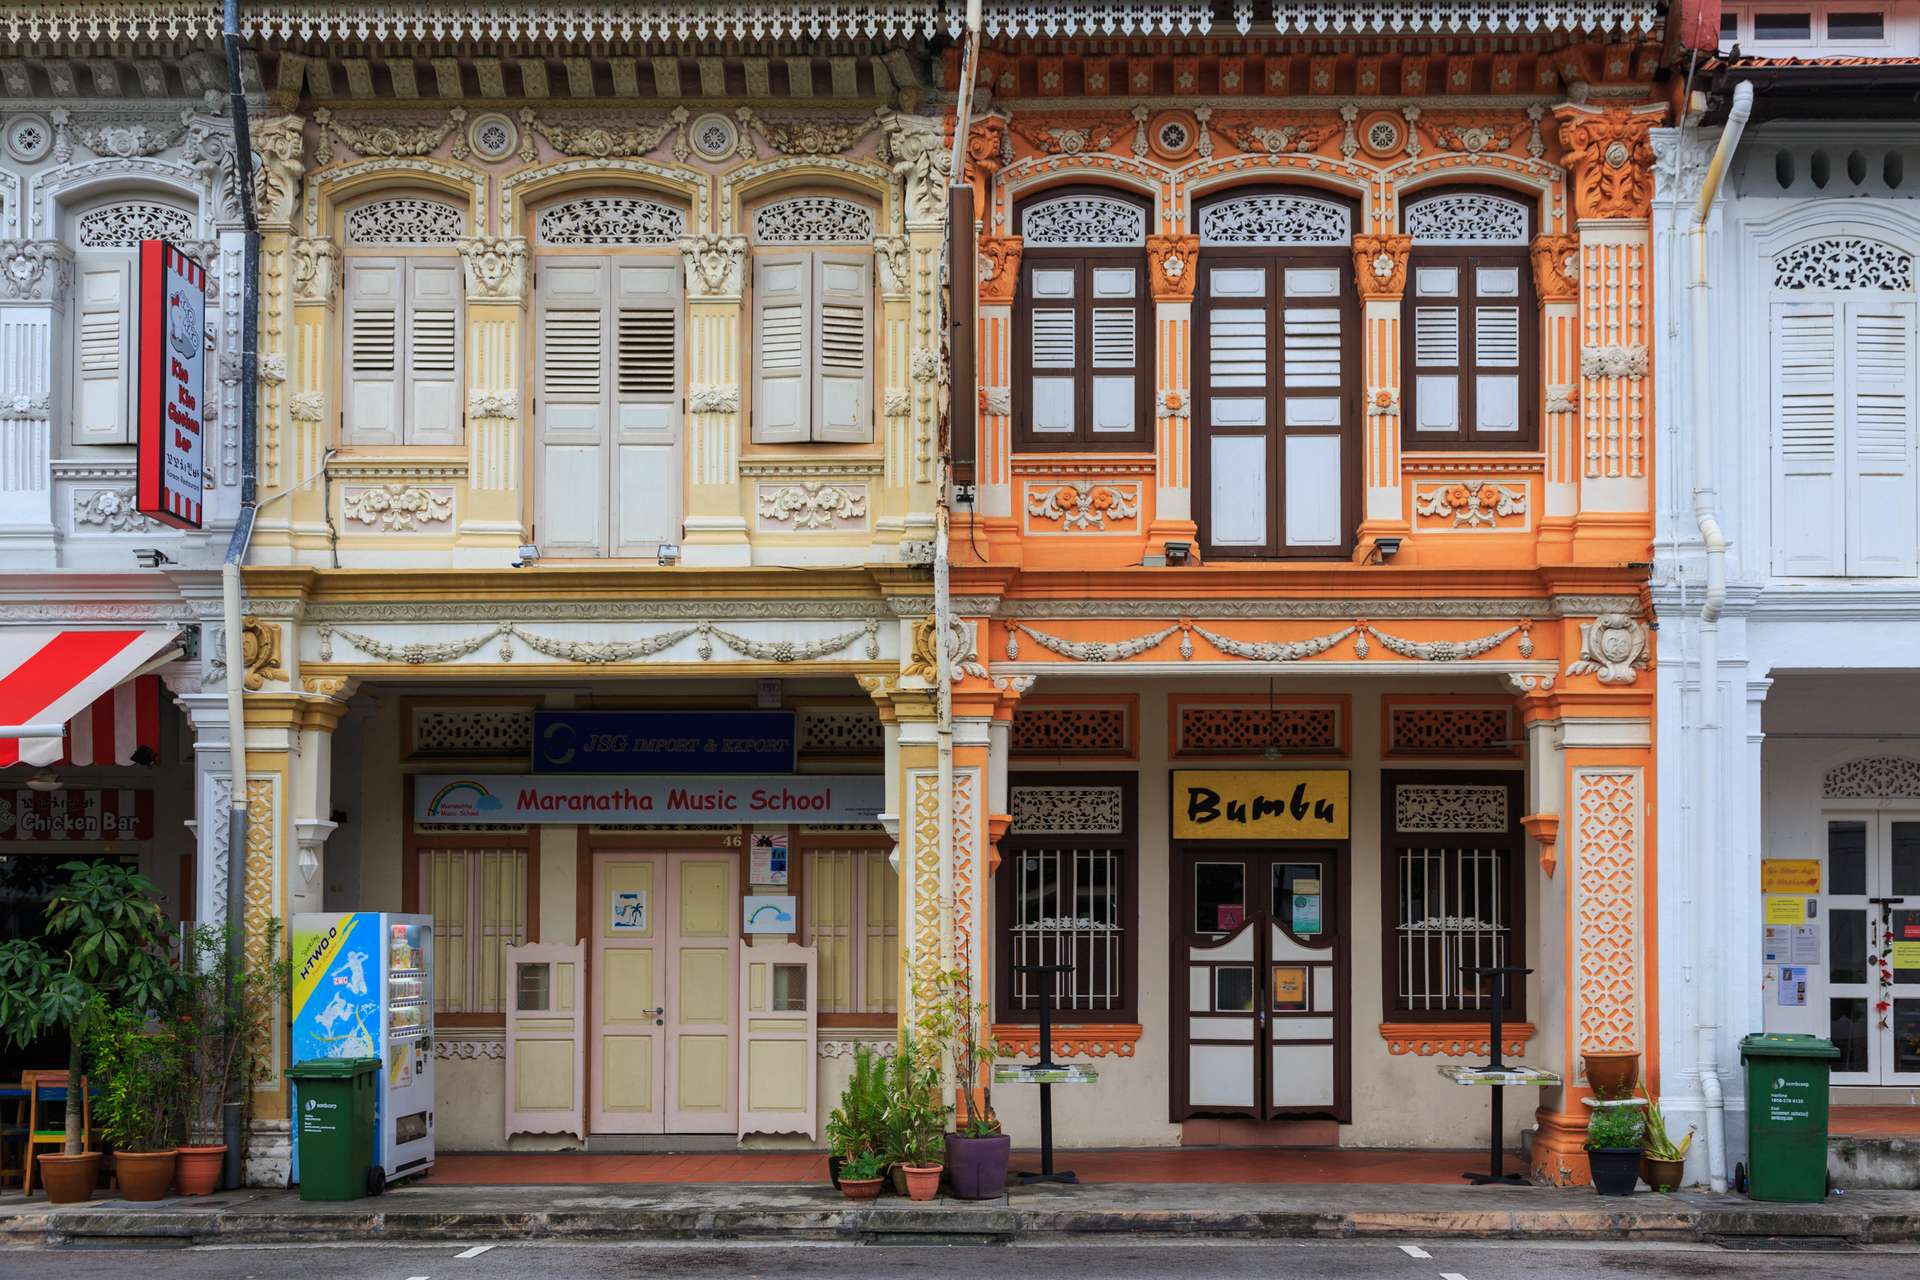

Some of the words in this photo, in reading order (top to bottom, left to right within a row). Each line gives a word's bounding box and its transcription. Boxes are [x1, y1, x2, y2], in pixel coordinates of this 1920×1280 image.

[168, 401, 200, 436] Chicken
[175, 428, 192, 453] Bar
[632, 738, 699, 752] IMPORT
[703, 739, 717, 752] &
[720, 738, 788, 752] EXPORT
[516, 788, 653, 811] Maranatha
[667, 788, 737, 811] Music
[749, 788, 831, 811] School
[1187, 783, 1335, 824] Bumbu
[22, 811, 97, 831] Chicken
[102, 811, 141, 831] Bar
[723, 836, 742, 847] 46
[300, 927, 337, 980] H-TWO-O
